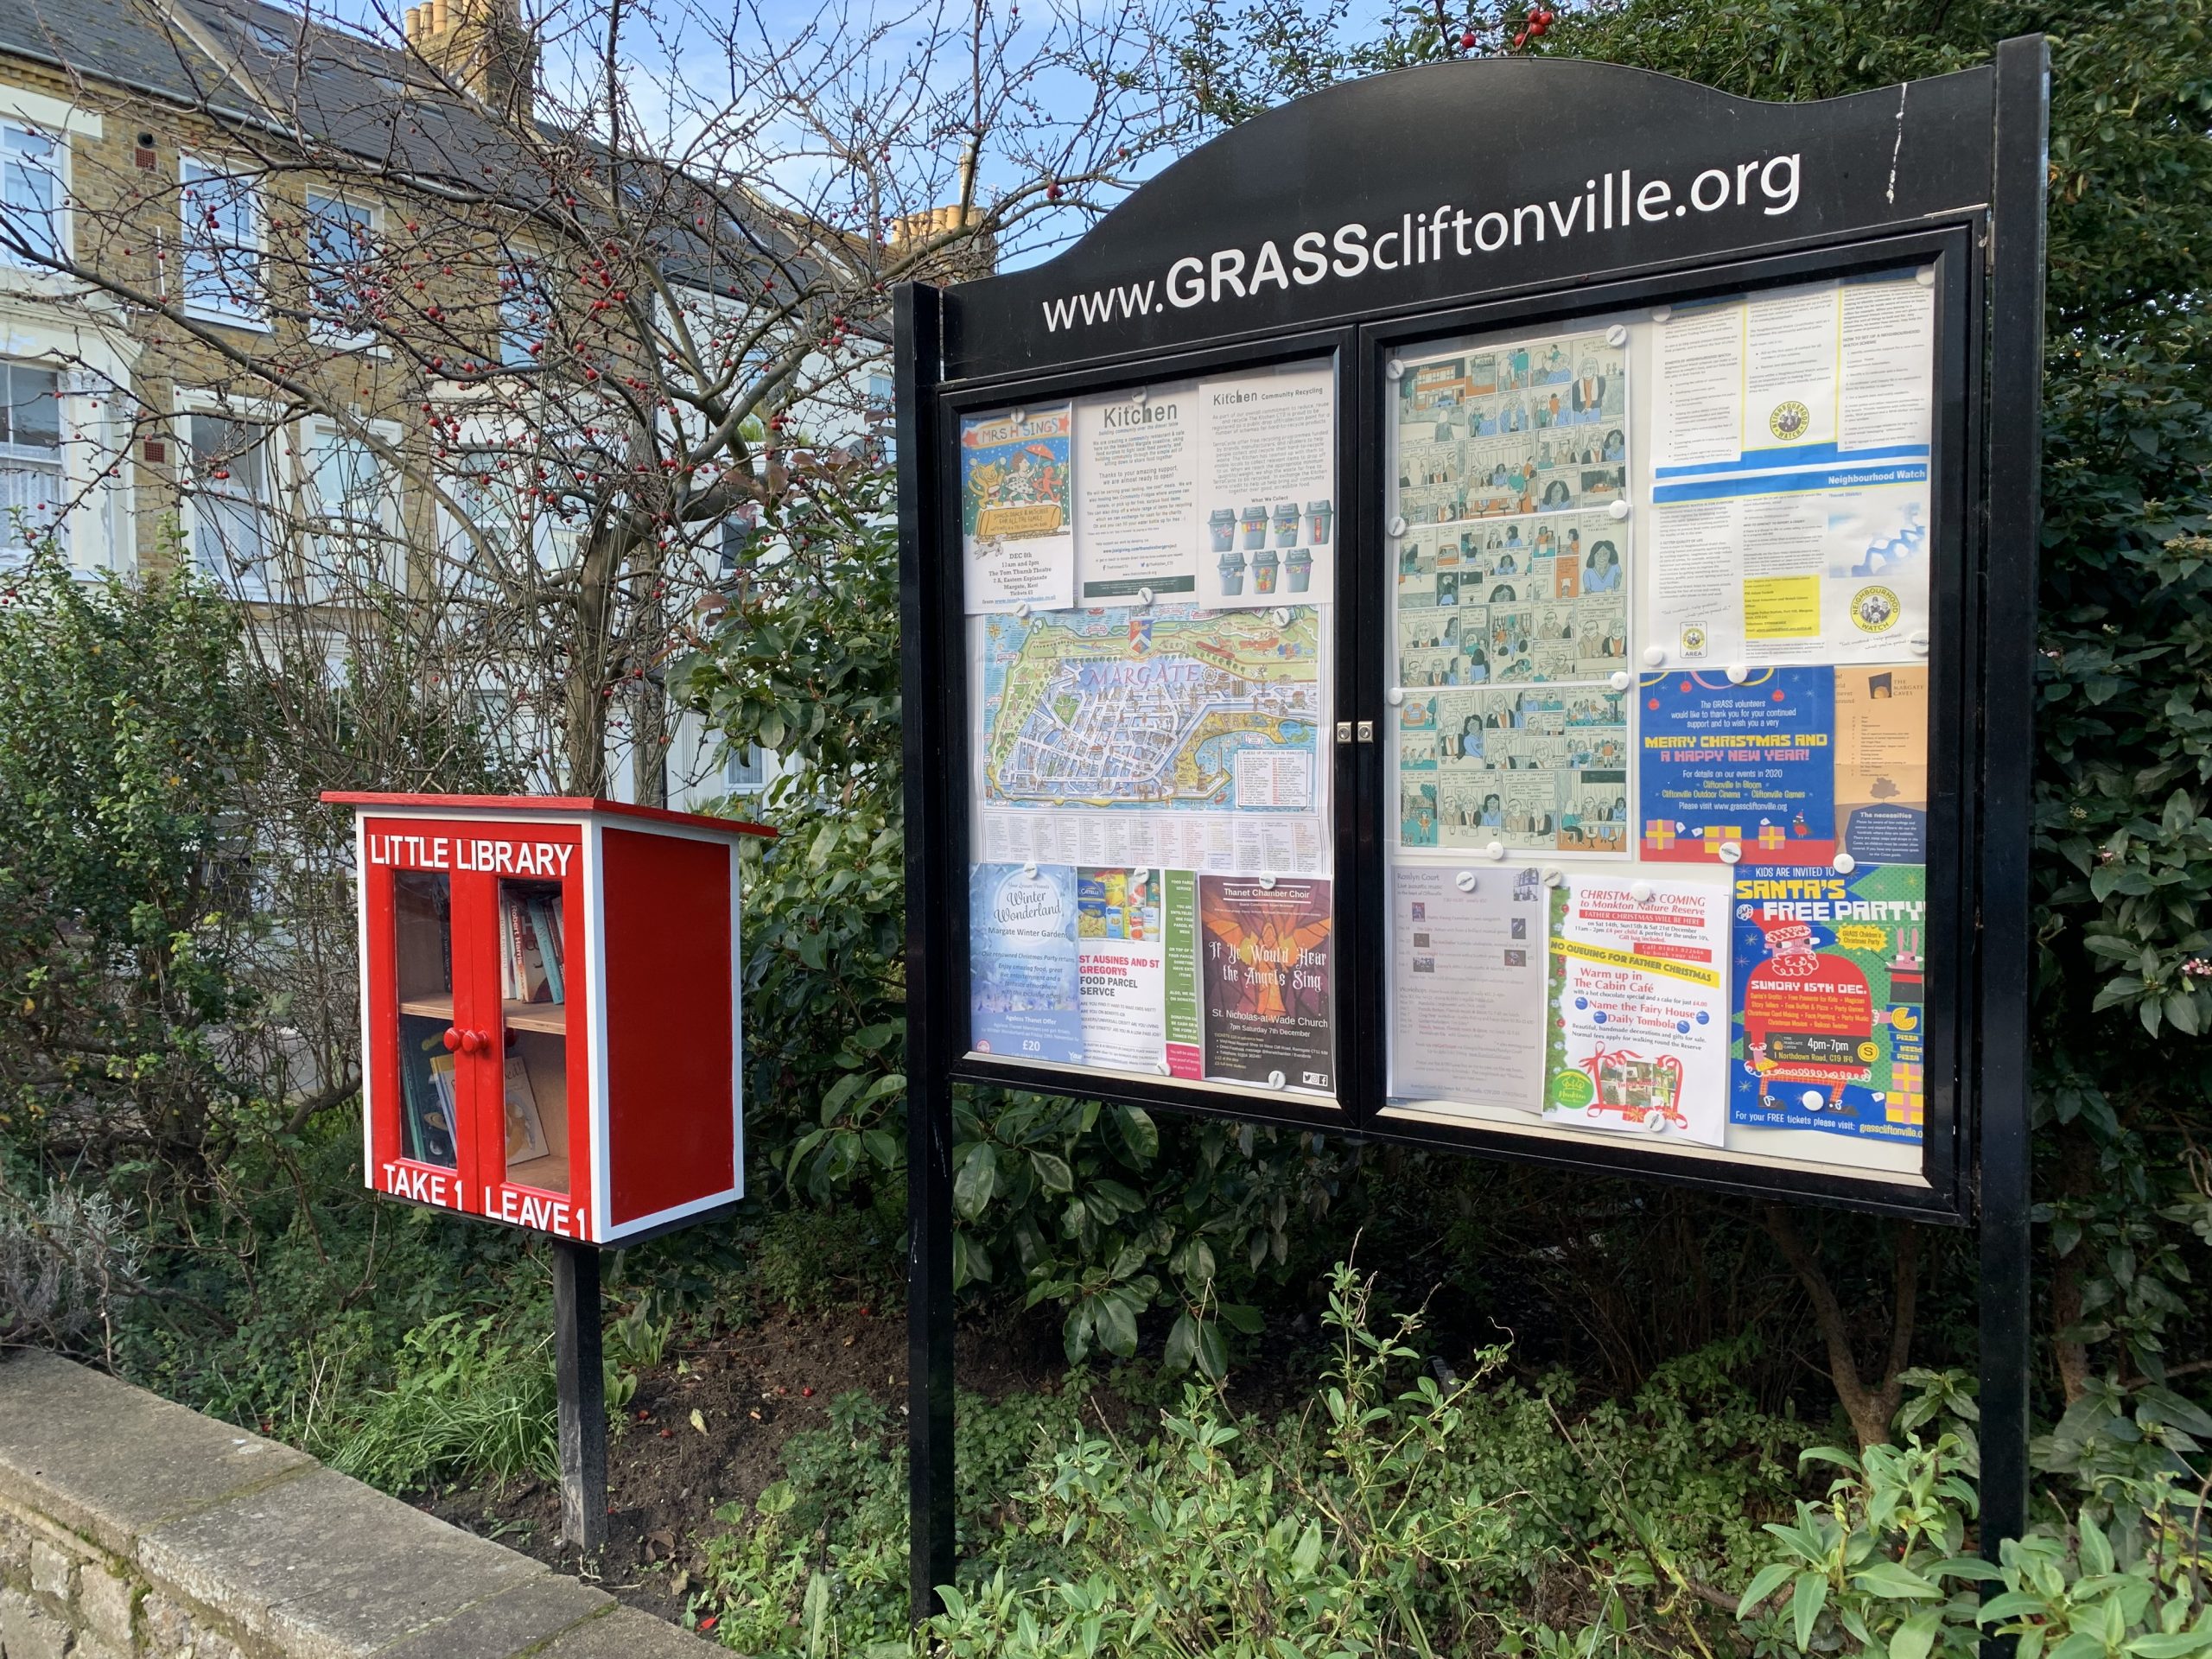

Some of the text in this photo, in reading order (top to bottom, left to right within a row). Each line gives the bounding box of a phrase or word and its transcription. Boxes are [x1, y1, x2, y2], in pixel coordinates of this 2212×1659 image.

[1041, 153, 1801, 334] www.GRASScliftonville.org
[1213, 387, 1323, 405] Kitchen Community Recycling
[1104, 402, 1177, 428] Kitchen
[982, 418, 1058, 442] MRS H SINGS
[1828, 470, 1925, 486] Neighbourhood Watch
[1853, 588, 1897, 615] NEIGHBOURHOOD
[1861, 622, 1889, 631] WATCH
[1082, 662, 1201, 690] MARGATE
[1700, 700, 1711, 709] The
[1671, 710, 1688, 719] would
[1728, 710, 1738, 719] you
[1751, 710, 1764, 719] your
[1766, 709, 1796, 717] continued
[1687, 721, 1709, 729] support
[1645, 736, 1696, 748] MERRY
[1796, 734, 1827, 747] AND
[1661, 748, 1809, 762] A HAPPY NEW YEAR!
[1765, 769, 1783, 778] 2020
[1714, 802, 1787, 812] www.grasscliftonville.org
[371, 835, 574, 876] LITTLE LIBRARY
[1756, 867, 1835, 877] KIDS ARE INVITED TO
[1224, 888, 1310, 899] Thanet Chamber Choir
[1736, 880, 1846, 899] SANTA'S
[1007, 891, 1046, 906] Winter
[1580, 890, 1637, 901] CHRISTM
[1660, 893, 1706, 907] COMING
[994, 899, 1061, 923] Wonderland
[1592, 900, 1634, 910] Monkton
[1637, 902, 1669, 912] Nature
[1671, 906, 1705, 915] Reserve
[1764, 901, 1830, 921] FREE
[512, 906, 520, 935] Robert
[1585, 911, 1609, 919] FATHER
[1612, 912, 1654, 921] CHRISTMAS
[988, 927, 1015, 936] Margate
[1092, 956, 1128, 965] AUSINES
[1131, 958, 1147, 967] AND
[1149, 959, 1160, 968] ST
[1208, 941, 1222, 961] If
[1248, 944, 1289, 963] Would
[1296, 947, 1327, 968] Hear
[1550, 941, 1711, 982] NO QUEUING FOR FATHER CHRISTMAS
[1080, 966, 1127, 976] GREGORYS
[1224, 964, 1322, 992] the Angels Sing
[1581, 968, 1642, 982] Warm up in
[1080, 976, 1137, 988] FOOD PARCEL
[1574, 978, 1654, 993] The Cabin Café
[1751, 981, 1866, 994] SUNDAY 15TH DEC.
[1080, 987, 1115, 996] SERVCE
[1590, 1001, 1695, 1019] Name the Fairy House
[1226, 1009, 1296, 1025] Nicholas-at-Wade
[1298, 1017, 1328, 1028] Church
[1608, 1014, 1675, 1029] Daily Tombola
[1243, 1025, 1267, 1034] Saturday
[1280, 1028, 1310, 1037] December
[1023, 1040, 1040, 1051] £20
[1808, 1038, 1849, 1051] 4pm-7pm
[1778, 1052, 1809, 1061] Northdown
[1735, 1111, 1747, 1120] For
[1749, 1113, 1764, 1122] your
[1767, 1114, 1783, 1122] FREE
[1787, 1115, 1811, 1125] tickets
[1814, 1117, 1835, 1128] please
[1838, 1120, 1855, 1130] visit:
[383, 1163, 463, 1211] TAKE 1
[486, 1185, 586, 1241] LEAVE 1
